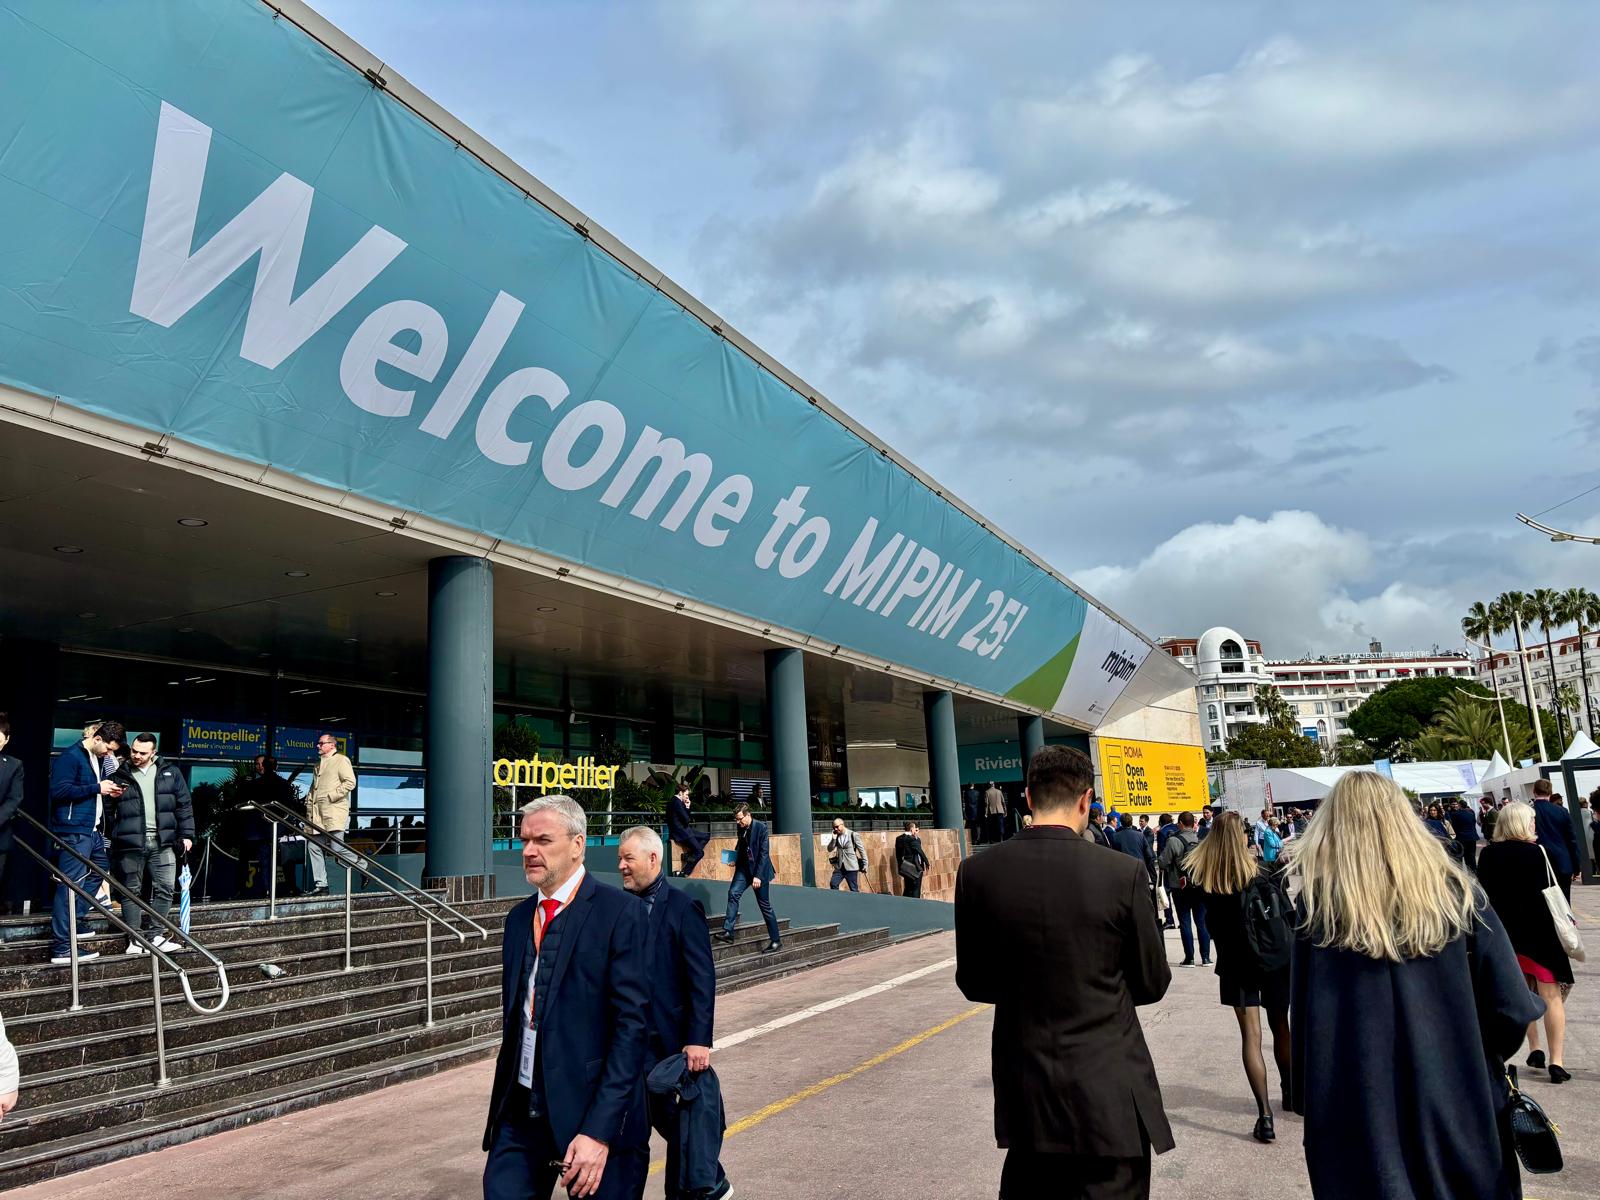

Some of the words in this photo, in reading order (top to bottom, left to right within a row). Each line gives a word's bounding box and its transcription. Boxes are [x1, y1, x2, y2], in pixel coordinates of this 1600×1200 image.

[129, 99, 754, 547] Welcome
[754, 485, 831, 579] to
[822, 516, 983, 640] MIPIM
[957, 589, 1029, 661] 25!
[1100, 649, 1137, 683] mipim
[187, 726, 261, 744] Montpellier
[1123, 746, 1143, 758] ROMA
[493, 752, 620, 796] ontpellier
[1125, 763, 1145, 778] Open
[1127, 779, 1135, 791] to
[1136, 778, 1148, 791] the
[1128, 793, 1152, 806] Future
